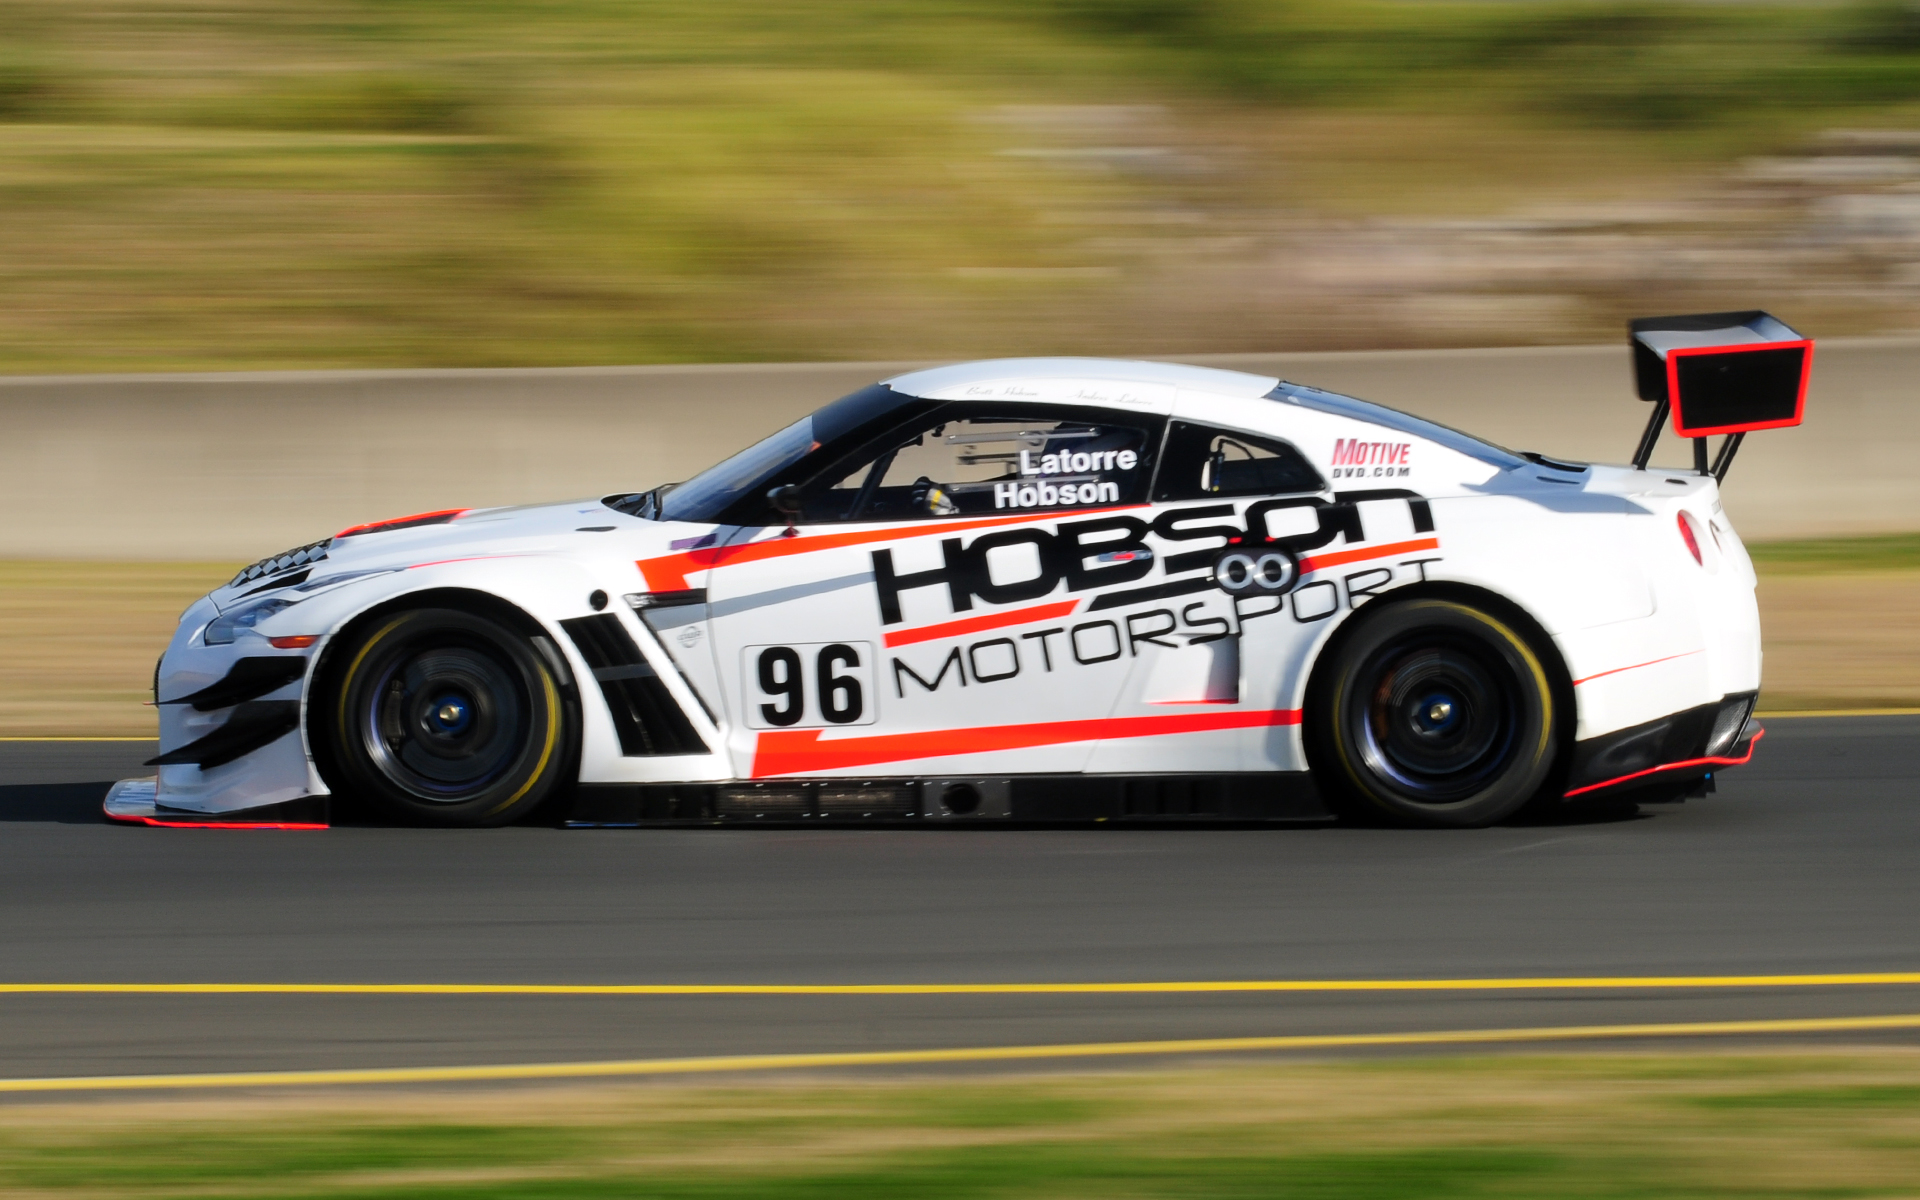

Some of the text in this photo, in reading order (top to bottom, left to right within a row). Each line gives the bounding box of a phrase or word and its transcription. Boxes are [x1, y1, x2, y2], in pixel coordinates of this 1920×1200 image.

[1020, 449, 1138, 475] Latorre
[1331, 438, 1411, 465] MOTIVE
[1333, 467, 1410, 478] DVD.COM
[994, 481, 1119, 508] Hobson
[891, 557, 1444, 698] MOTORSPORT
[757, 644, 863, 727] 96
